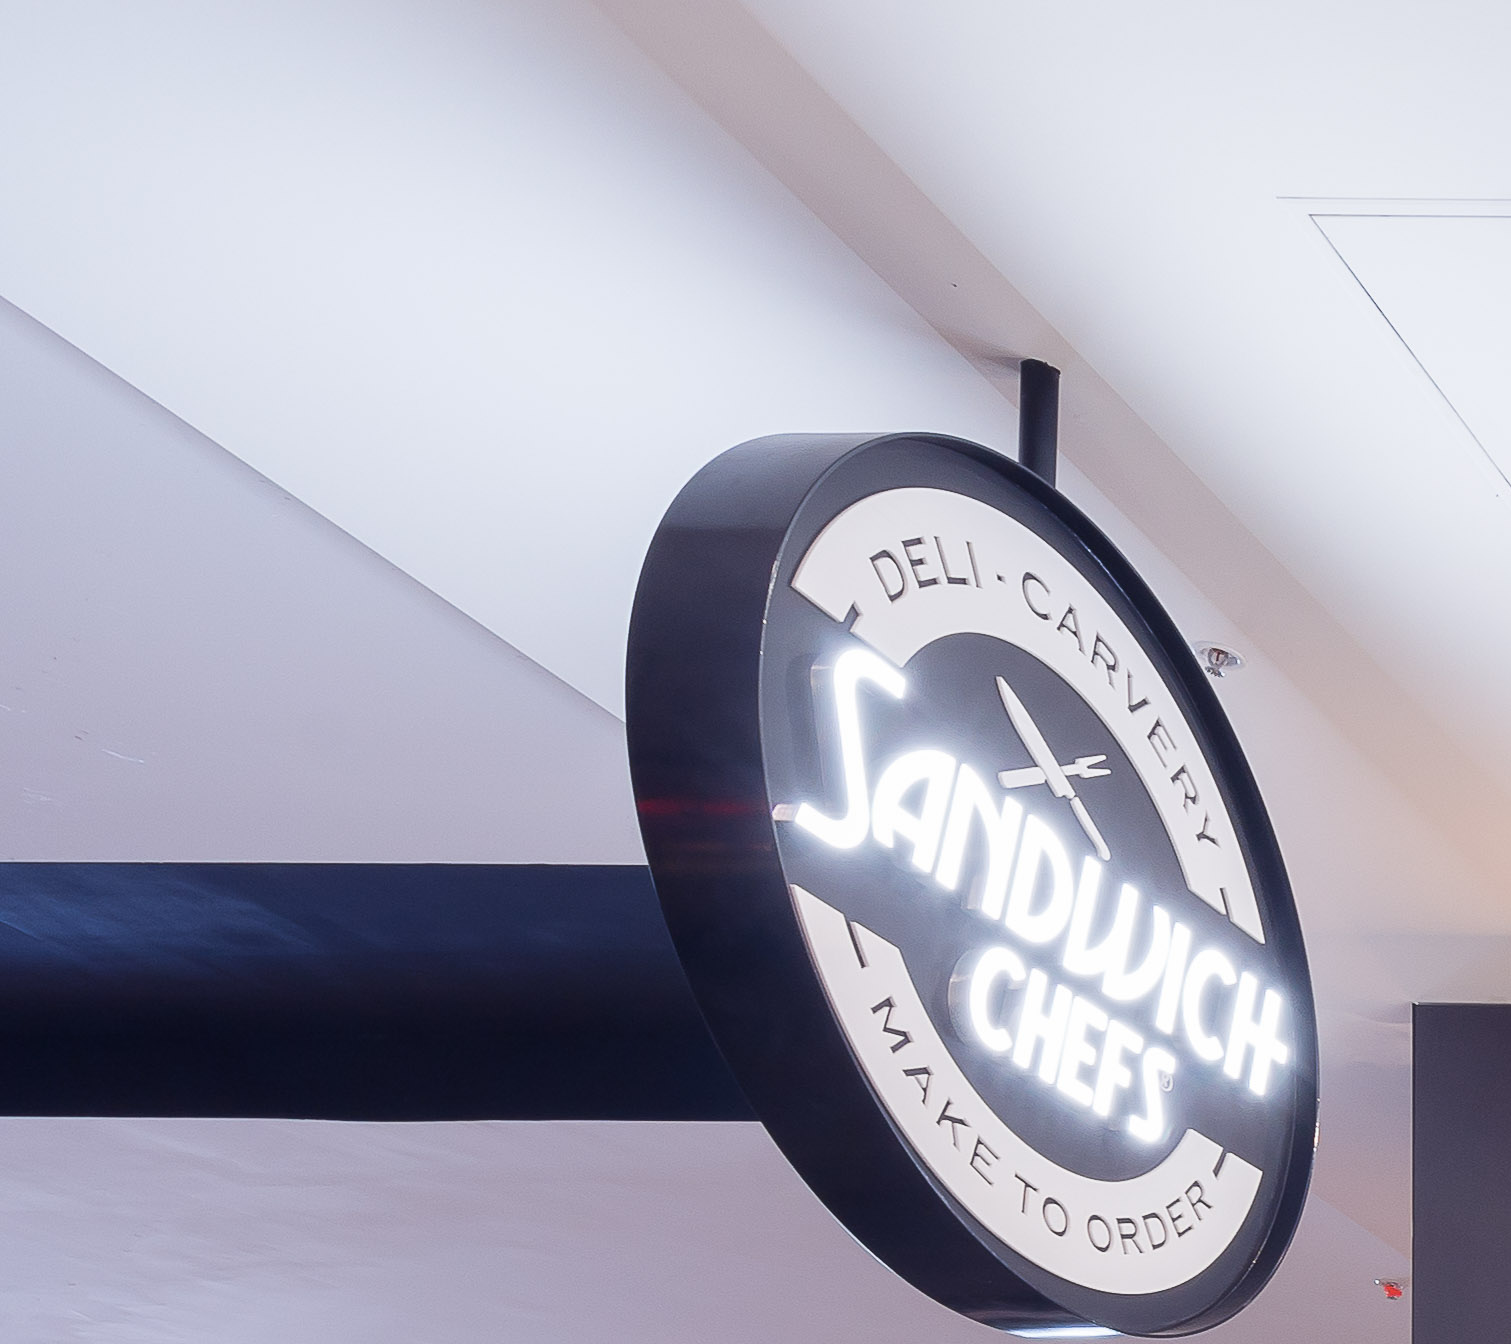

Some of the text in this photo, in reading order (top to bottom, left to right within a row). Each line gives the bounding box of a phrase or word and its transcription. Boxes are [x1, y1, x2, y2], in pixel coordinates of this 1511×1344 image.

[869, 535, 1221, 849] DELI CARVERY
[795, 647, 1287, 1095] SANDWICH
[869, 996, 1214, 1256] MAKE TO ORDER
[969, 947, 1177, 1144] CHEFS
